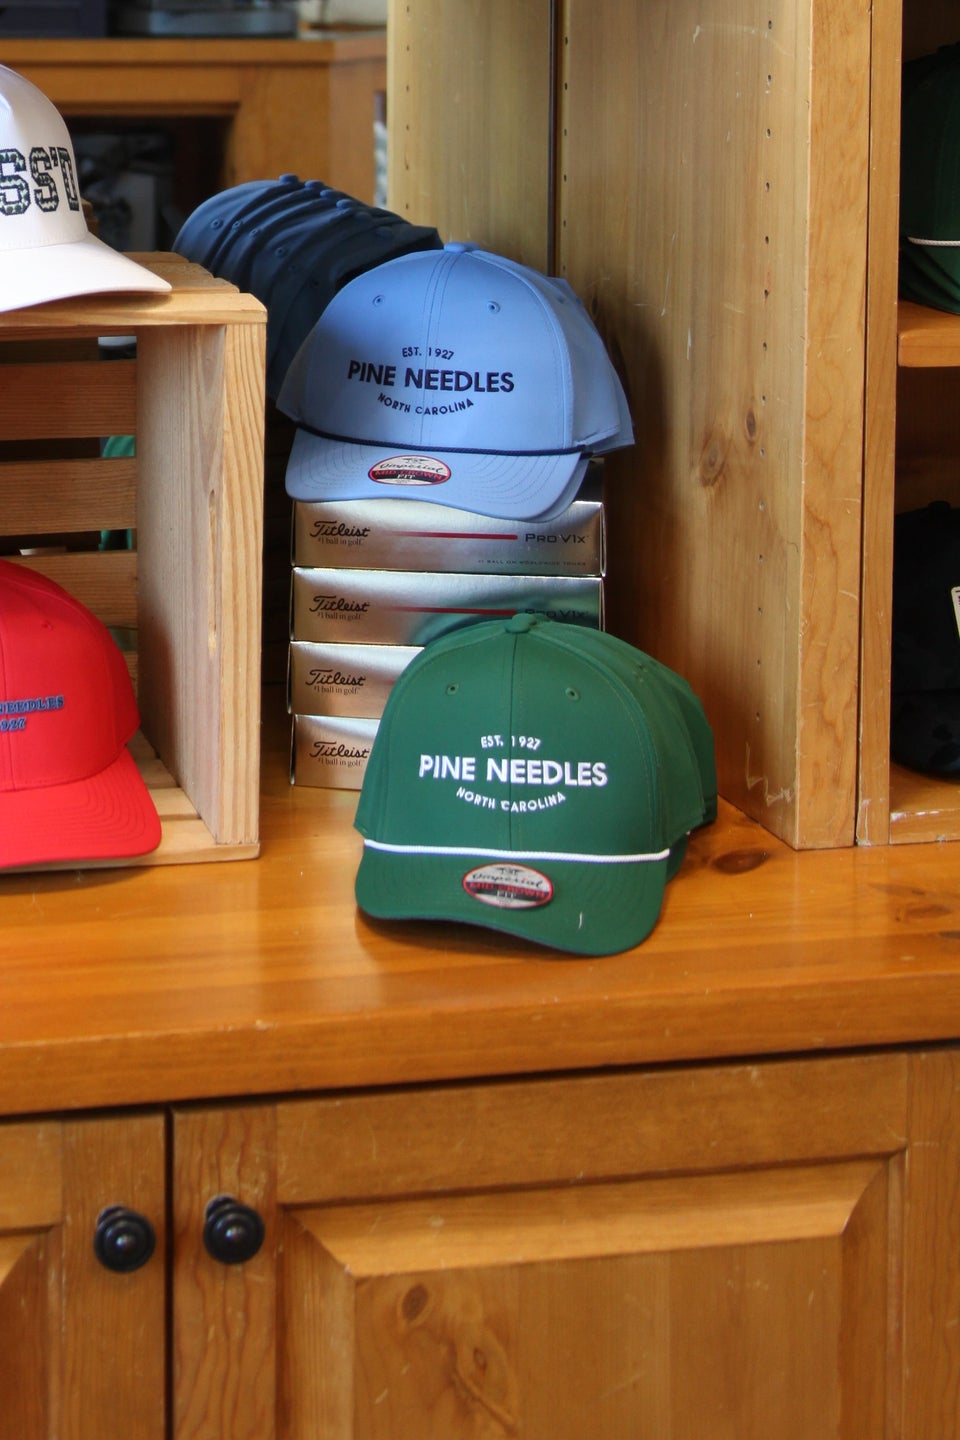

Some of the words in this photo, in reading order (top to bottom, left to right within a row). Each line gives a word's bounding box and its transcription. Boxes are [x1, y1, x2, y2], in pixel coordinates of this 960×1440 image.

[402, 347, 422, 358] EST.
[428, 347, 455, 360] 1927
[347, 360, 396, 387] PINE
[404, 367, 515, 393] NEEDLES
[377, 393, 411, 413] NORTH
[415, 398, 474, 416] CAROLINA
[309, 521, 371, 537] Titleist
[309, 595, 370, 612] Titleist
[305, 669, 366, 686] Titleist
[309, 741, 370, 758] Titleist
[481, 735, 504, 748] EST.
[511, 735, 541, 750] 1927
[418, 754, 476, 781] PINE
[486, 758, 608, 787] NEEDLES
[456, 787, 496, 809] NORTH
[501, 791, 566, 813] CAROLINA
